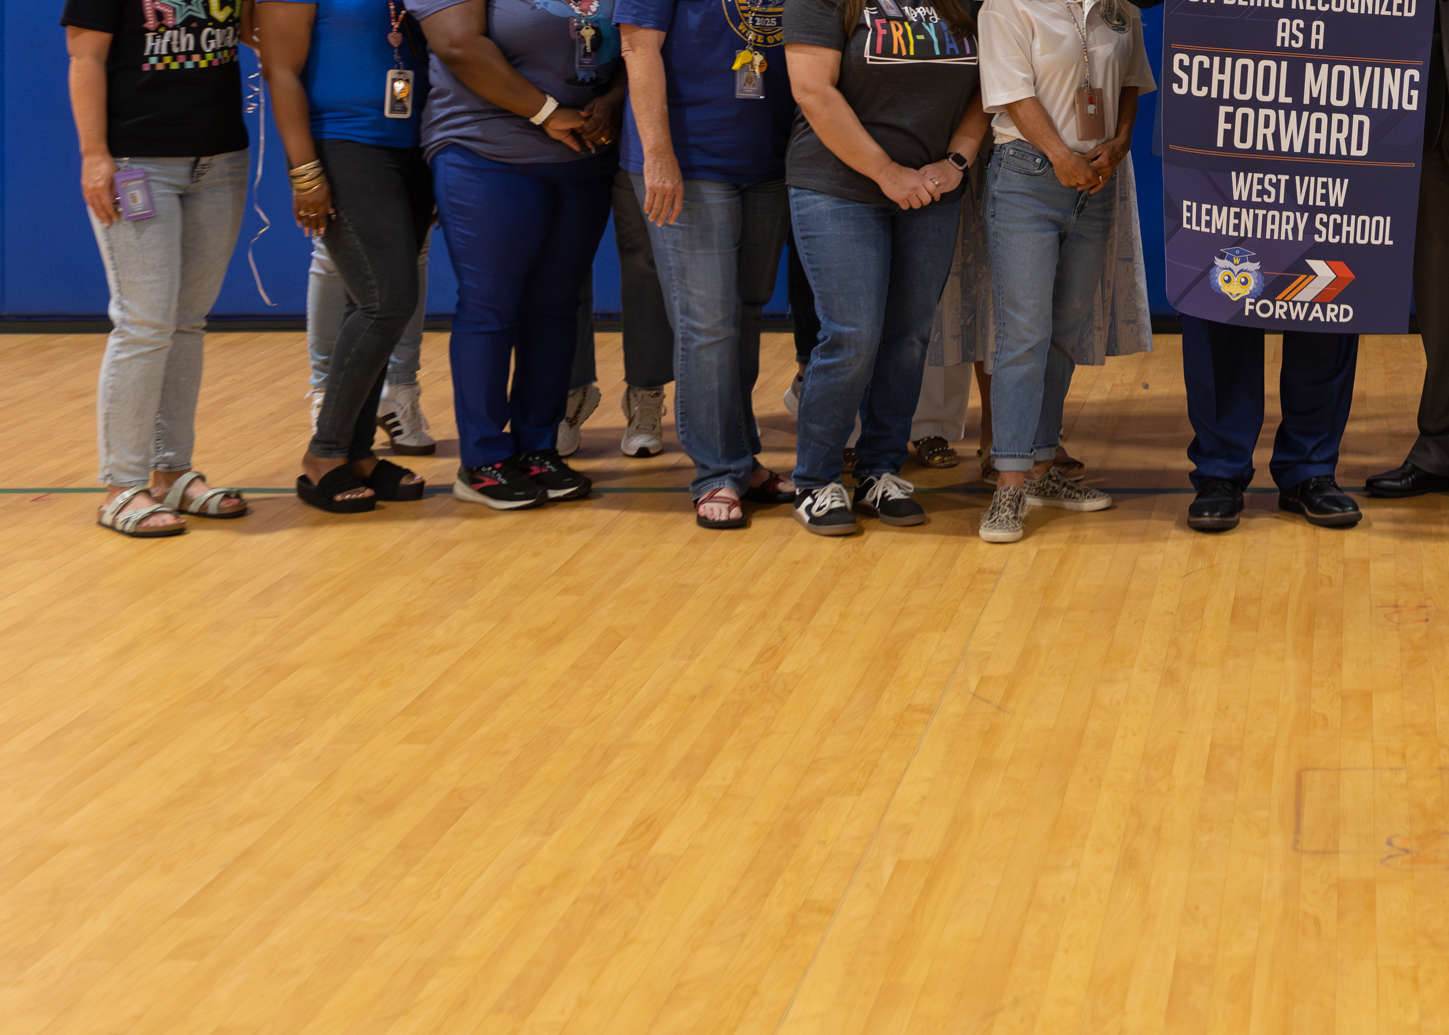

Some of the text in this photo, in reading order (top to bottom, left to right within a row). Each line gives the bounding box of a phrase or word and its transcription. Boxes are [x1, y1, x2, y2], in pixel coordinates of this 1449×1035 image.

[754, 16, 777, 27] 2025
[874, 18, 972, 56] FRI-YA
[1276, 18, 1325, 50] AS A
[143, 25, 241, 56] Fifth Gra
[1172, 53, 1421, 111] SCHOOL MOVING
[1216, 105, 1371, 157] FORWARD
[1231, 171, 1349, 208] WEST VIEW
[1182, 200, 1394, 246] ELEMENTARY SCHOOL
[1232, 256, 1241, 265] W
[1244, 297, 1354, 323] FORWARD
